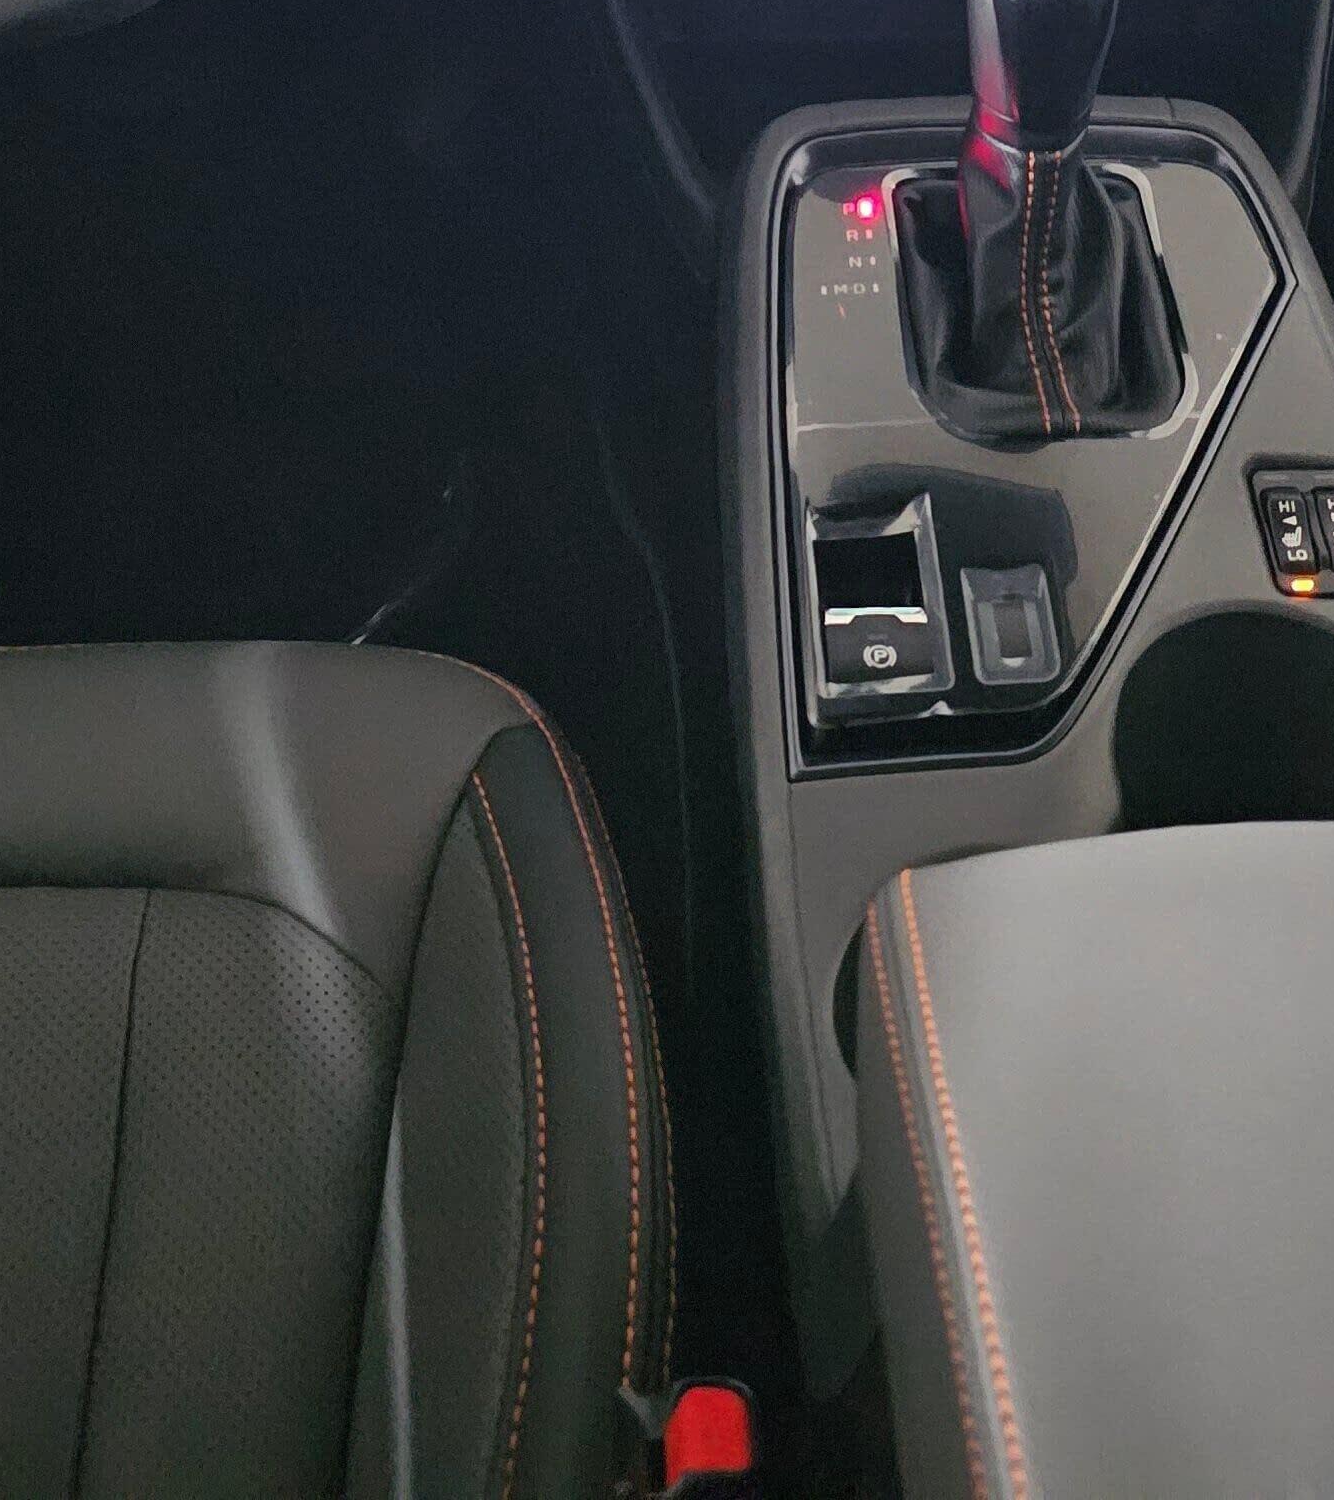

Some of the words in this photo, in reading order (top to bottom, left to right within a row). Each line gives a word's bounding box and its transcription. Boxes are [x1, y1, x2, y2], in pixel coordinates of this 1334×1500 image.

[842, 203, 855, 215] P
[846, 230, 859, 241] R
[849, 256, 862, 268] N
[834, 284, 848, 294] M
[854, 283, 866, 294] D
[1279, 501, 1296, 513] HI
[1287, 549, 1308, 561] LO
